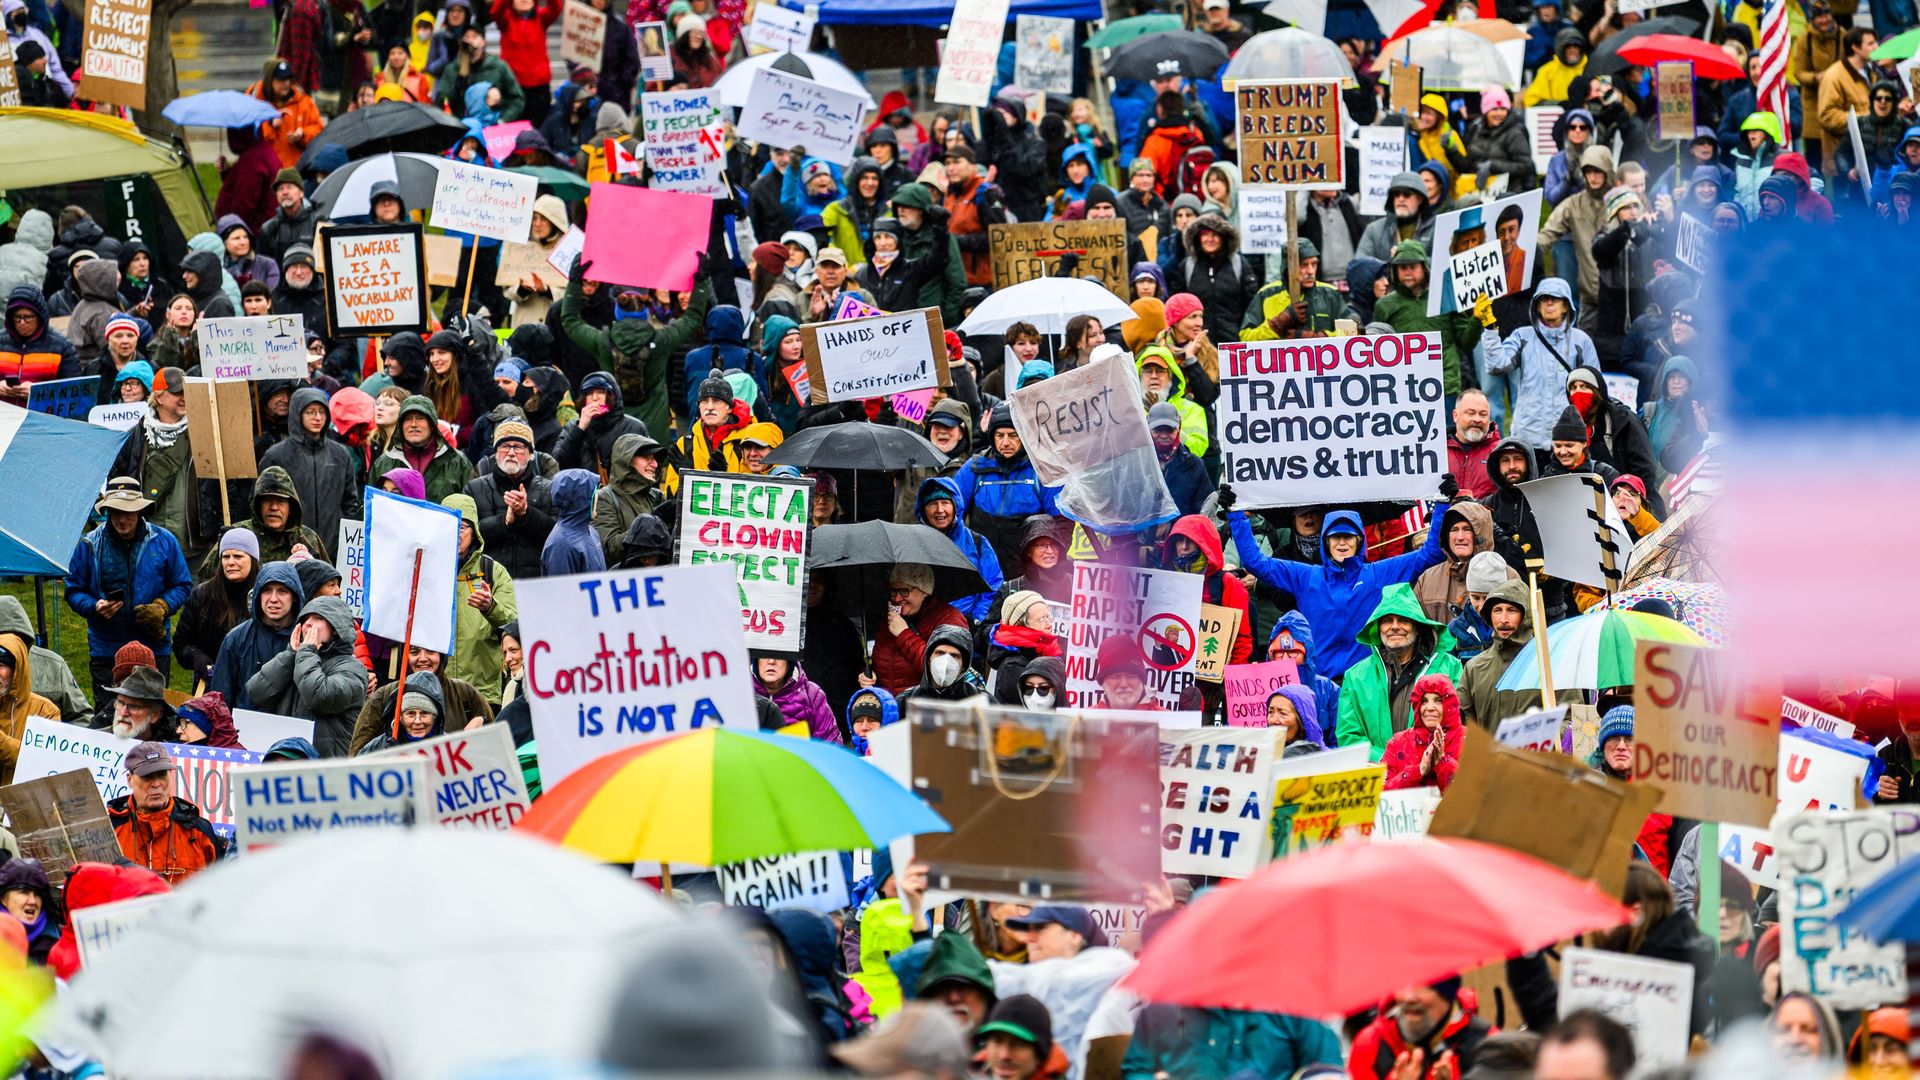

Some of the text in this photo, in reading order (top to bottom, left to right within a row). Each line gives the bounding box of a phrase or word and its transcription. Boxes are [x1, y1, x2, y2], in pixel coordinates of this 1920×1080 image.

[90, 6, 150, 36] RESPECT
[89, 30, 146, 58] WOMENS
[673, 96, 710, 112] POWER
[1239, 84, 1329, 111] TRUMP
[645, 114, 714, 131] OF PEOPLE
[1243, 114, 1328, 135] BREEDS
[647, 133, 657, 144] IS
[648, 143, 697, 157] THAN THE
[1263, 138, 1318, 162] NAZI
[654, 156, 697, 169] PEOPLE
[1250, 162, 1327, 183] SCUM
[471, 169, 485, 184] the
[442, 184, 459, 195] are
[121, 180, 143, 243] FIR
[473, 208, 496, 222] States
[510, 216, 524, 226] NOT
[1053, 224, 1125, 250] SERVANTS
[351, 258, 391, 273] IS A
[1452, 250, 1500, 280] Listen
[338, 271, 401, 290] FASCIST
[1463, 279, 1472, 288] to
[341, 286, 414, 308] VOCABULARY
[353, 308, 395, 325] WORD
[205, 322, 253, 340] This is
[824, 319, 913, 350] HANDS OFF
[205, 344, 213, 358] A
[219, 341, 258, 356] MORAL
[860, 345, 901, 364] our
[1219, 343, 1340, 376] Trump
[215, 363, 298, 379] RIGHT Wrong
[37, 383, 91, 403] HANDS
[1220, 373, 1443, 412] TRAITOR to
[103, 411, 140, 423] HANDS
[1225, 408, 1439, 445] democracy,
[1226, 443, 1439, 483] laws & truth
[690, 480, 807, 524] ELECT A
[698, 520, 803, 554] CLOWN
[578, 576, 666, 617] THE
[1072, 594, 1145, 626] RAPIST
[528, 631, 728, 700] Constitution
[616, 703, 677, 734] NOT
[690, 697, 725, 729] A
[1811, 711, 1839, 733] Your
[1684, 723, 1727, 747] OUR
[24, 728, 125, 767] DEMOCRACY
[96, 766, 120, 780] IN
[244, 768, 415, 807] HELL NO!
[435, 768, 516, 814] NEVER
[1312, 776, 1381, 802] SUPPORT
[1198, 785, 1230, 814] IS
[1239, 791, 1261, 820] A
[248, 815, 286, 834] Not
[292, 813, 324, 832] My
